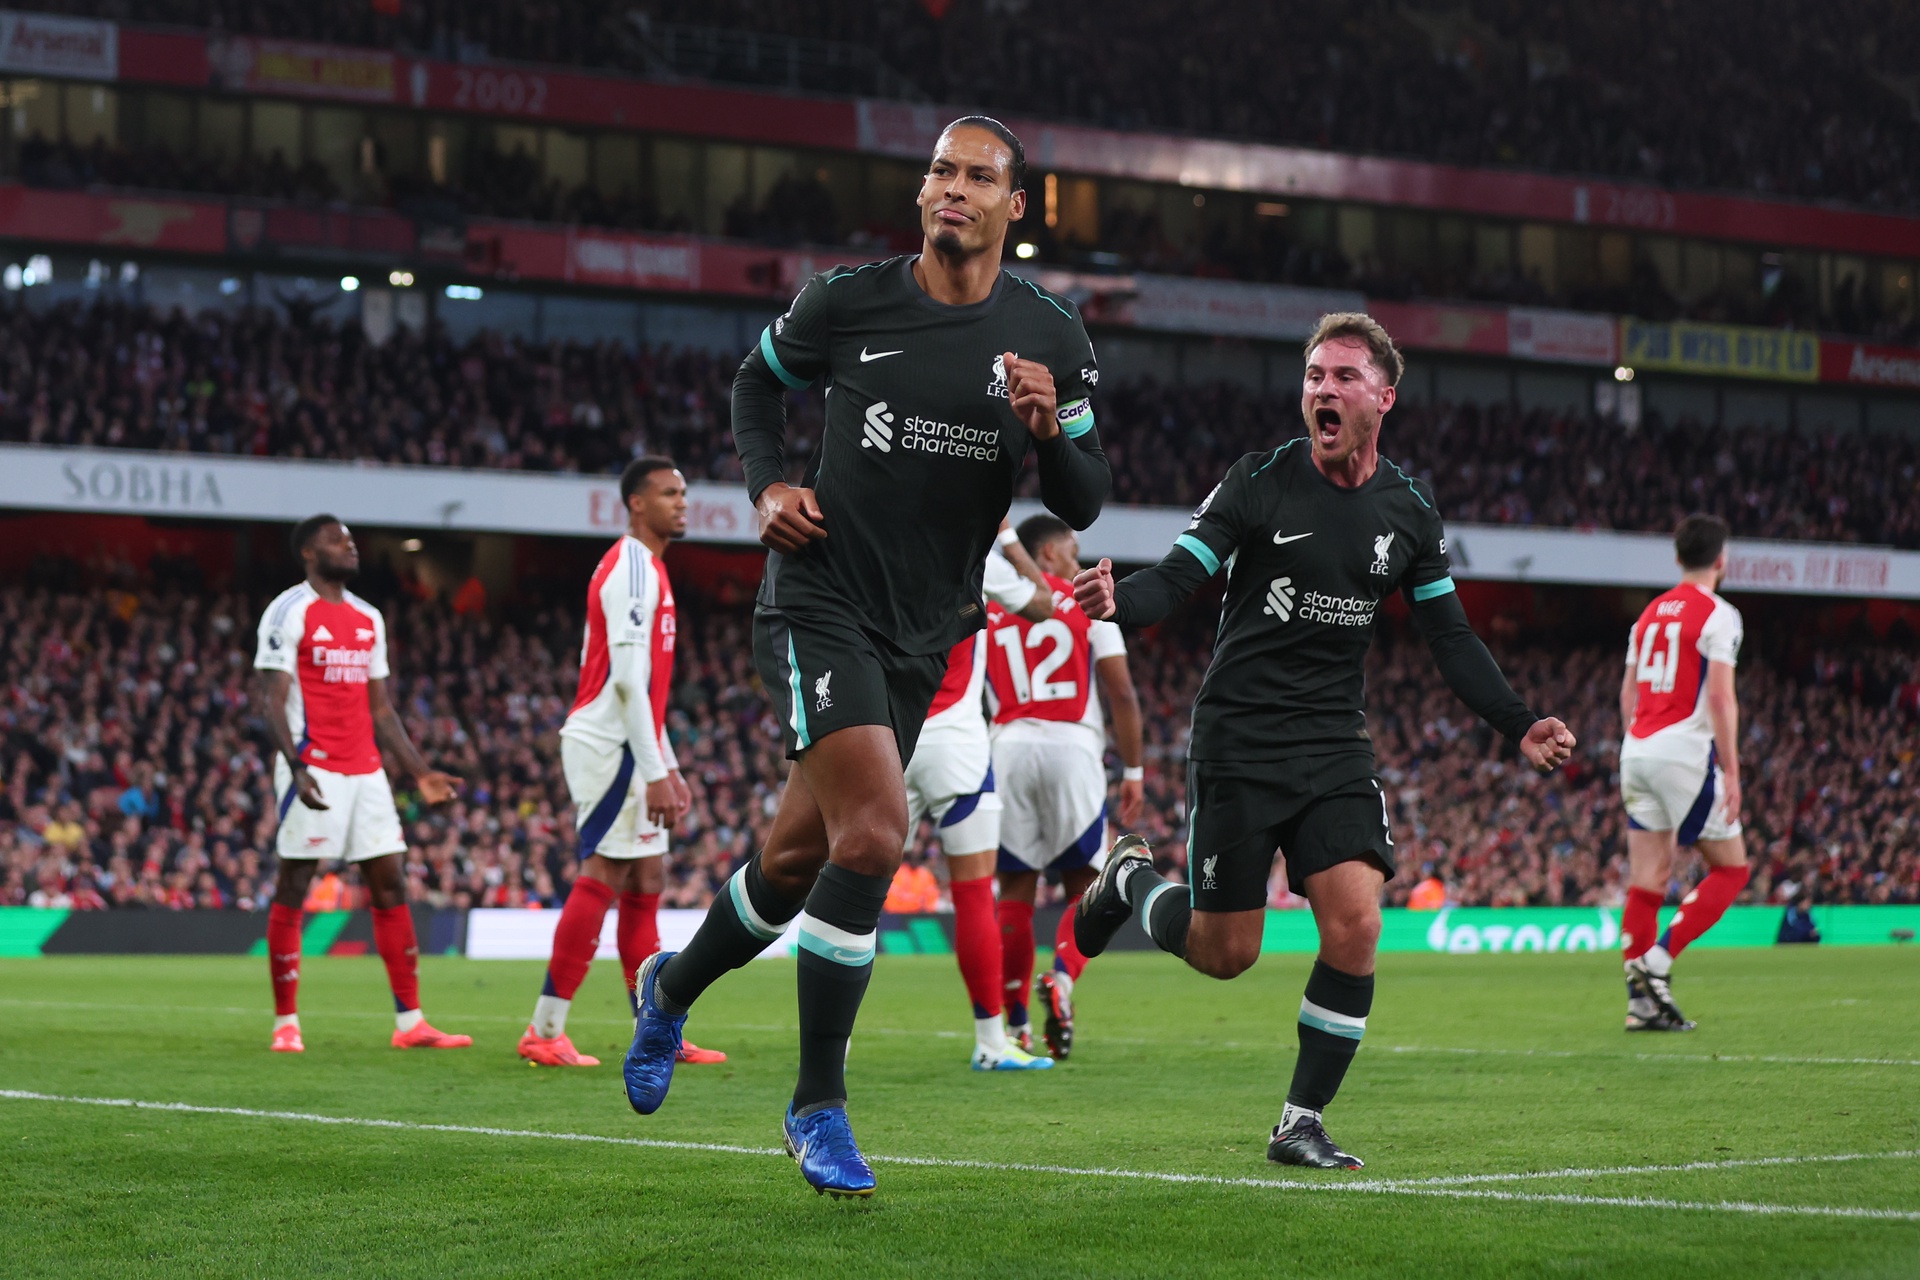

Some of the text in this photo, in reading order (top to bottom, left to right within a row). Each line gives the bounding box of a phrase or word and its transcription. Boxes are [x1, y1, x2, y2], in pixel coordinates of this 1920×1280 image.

[453, 69, 548, 115] 2002
[903, 415, 999, 445] standard
[901, 433, 999, 462] chartered
[1298, 605, 1375, 627] chartered
[1302, 590, 1379, 612] standard
[993, 618, 1078, 705] 12
[1636, 621, 1682, 694] 41
